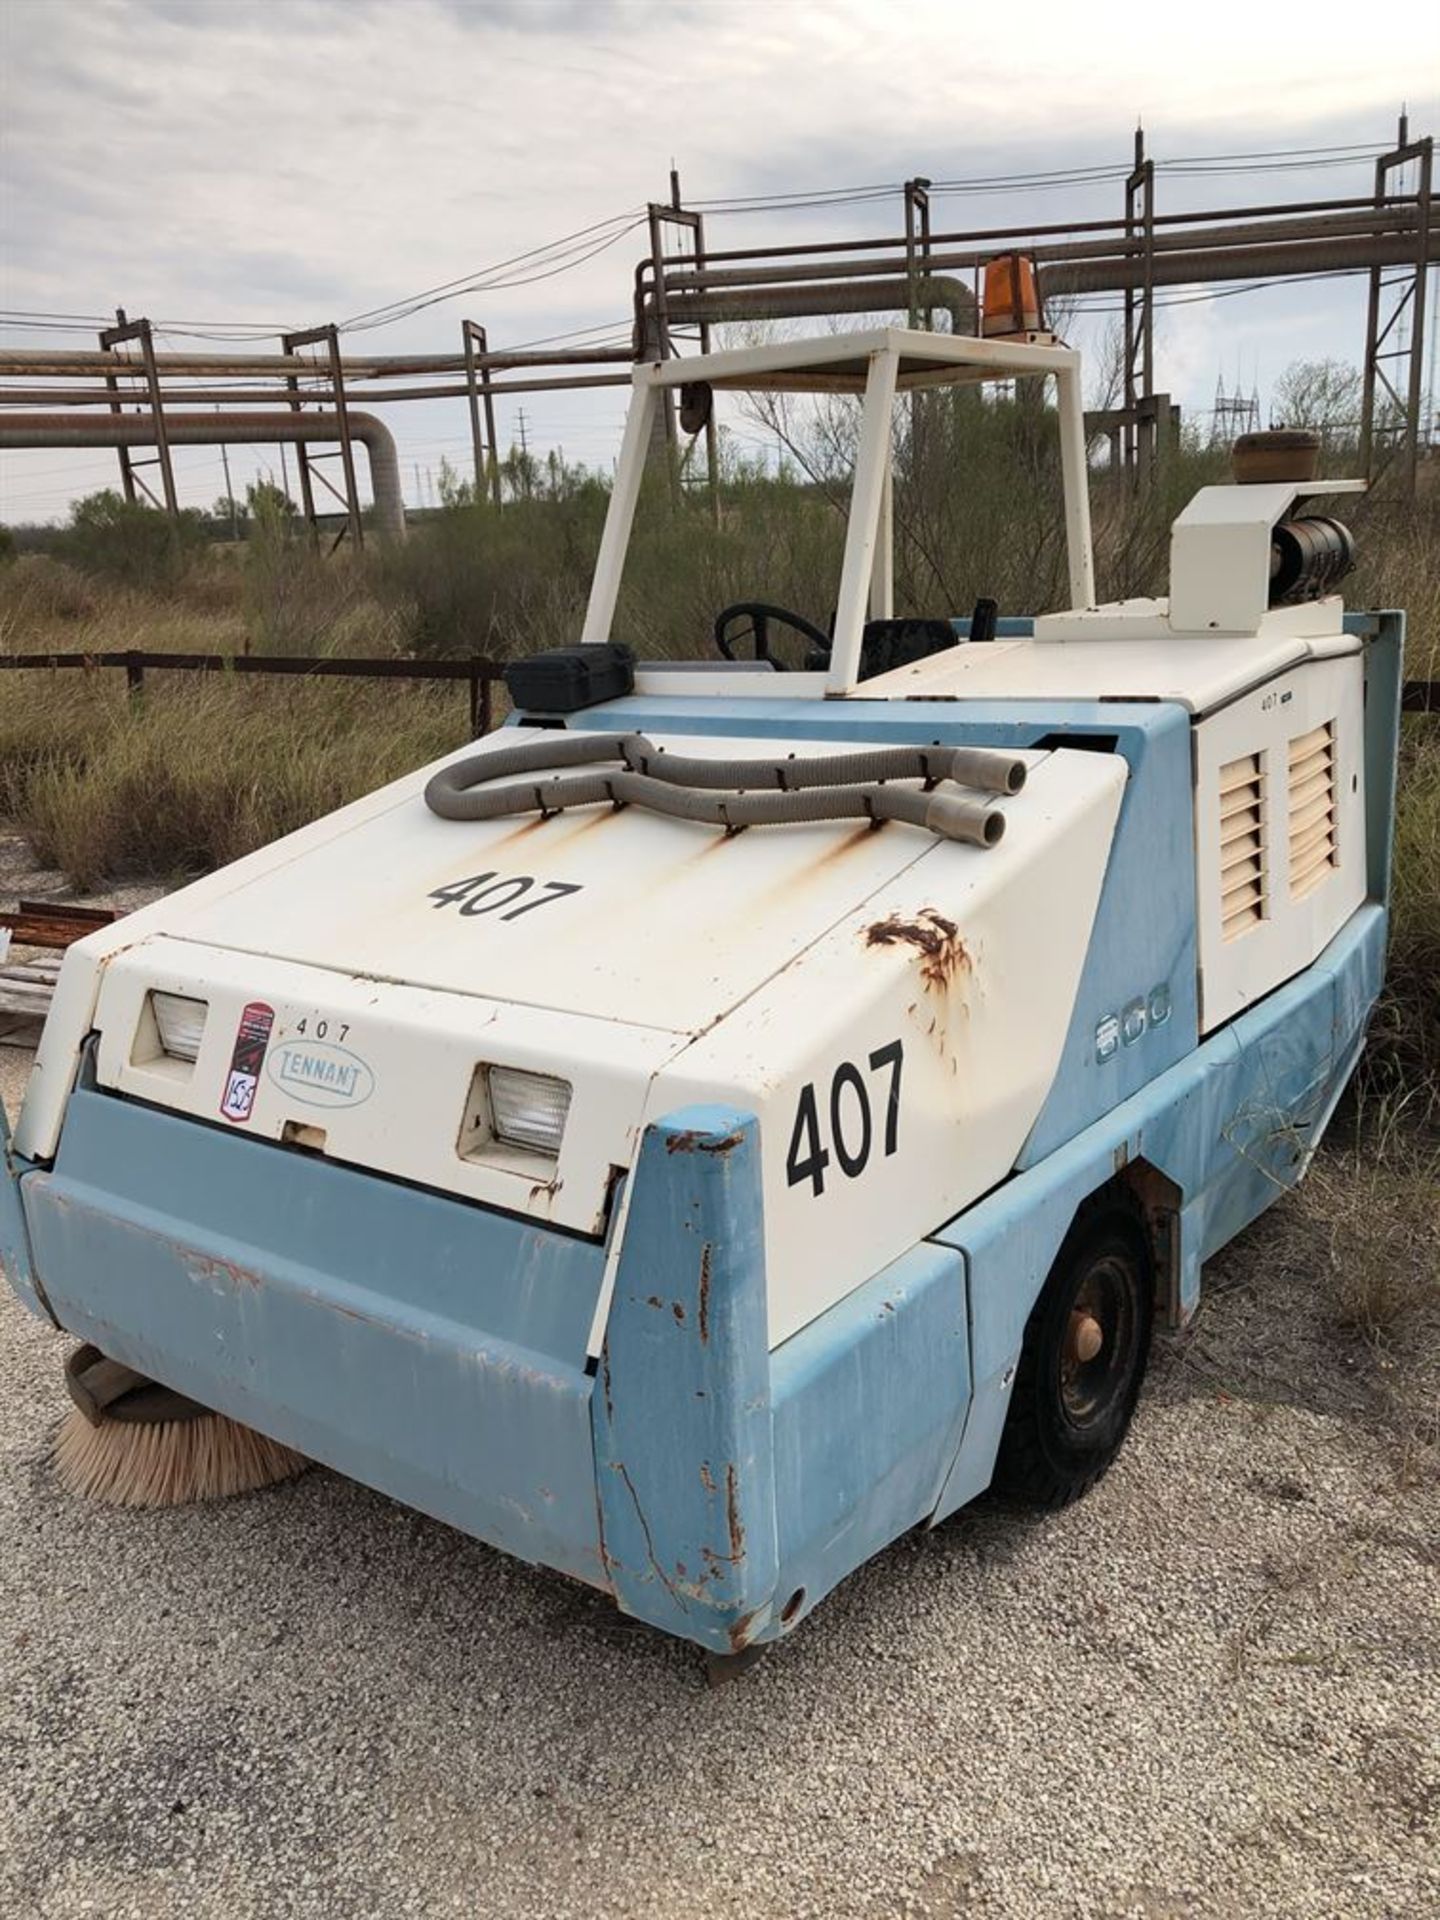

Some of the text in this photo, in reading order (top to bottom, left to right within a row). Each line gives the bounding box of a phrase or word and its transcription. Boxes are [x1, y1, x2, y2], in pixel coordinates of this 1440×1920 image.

[427, 872, 584, 921] 407
[296, 1017, 350, 1043] 407
[280, 1050, 362, 1097] TENNANT
[786, 1037, 904, 1198] 407
